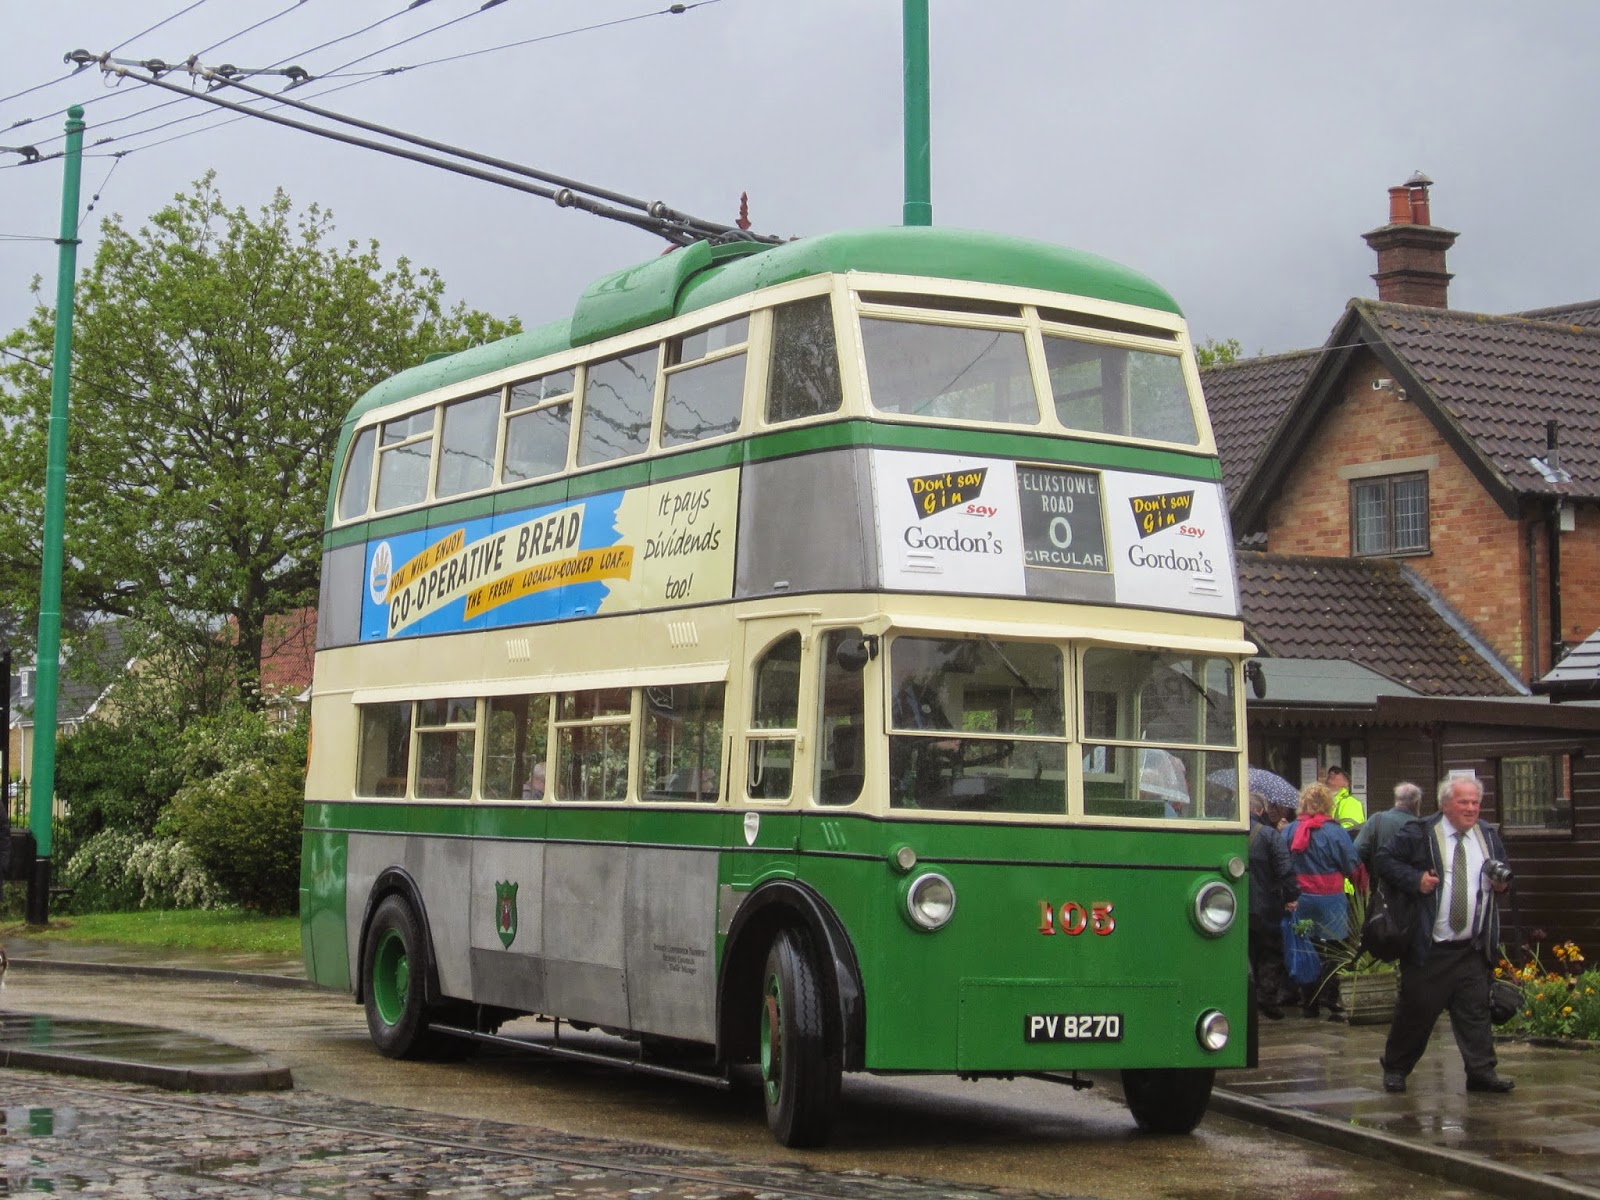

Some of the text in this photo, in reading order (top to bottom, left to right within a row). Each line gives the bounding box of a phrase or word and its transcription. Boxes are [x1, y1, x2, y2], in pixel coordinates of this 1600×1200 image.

[912, 472, 982, 494] Don't say
[658, 488, 711, 526] It pays
[924, 491, 962, 514] Gin
[966, 504, 997, 518] say
[1041, 494, 1074, 514] ROAD
[1133, 495, 1190, 513] Don't say
[1143, 511, 1176, 533] Gin
[1180, 525, 1205, 538] say
[644, 523, 721, 560] Dividends
[904, 526, 1003, 555] Gordon's
[390, 530, 463, 592] YOU WILL ENJOY
[391, 511, 580, 630] CO-OPERATIVE BREAD
[1024, 550, 1104, 567] CIRCULAR
[1128, 544, 1213, 574] Gordon's
[467, 589, 482, 611] THE
[488, 578, 514, 601] FRESH
[665, 573, 693, 599] too!
[1038, 900, 1115, 936] 105
[1030, 1015, 1120, 1038] PV 8270
